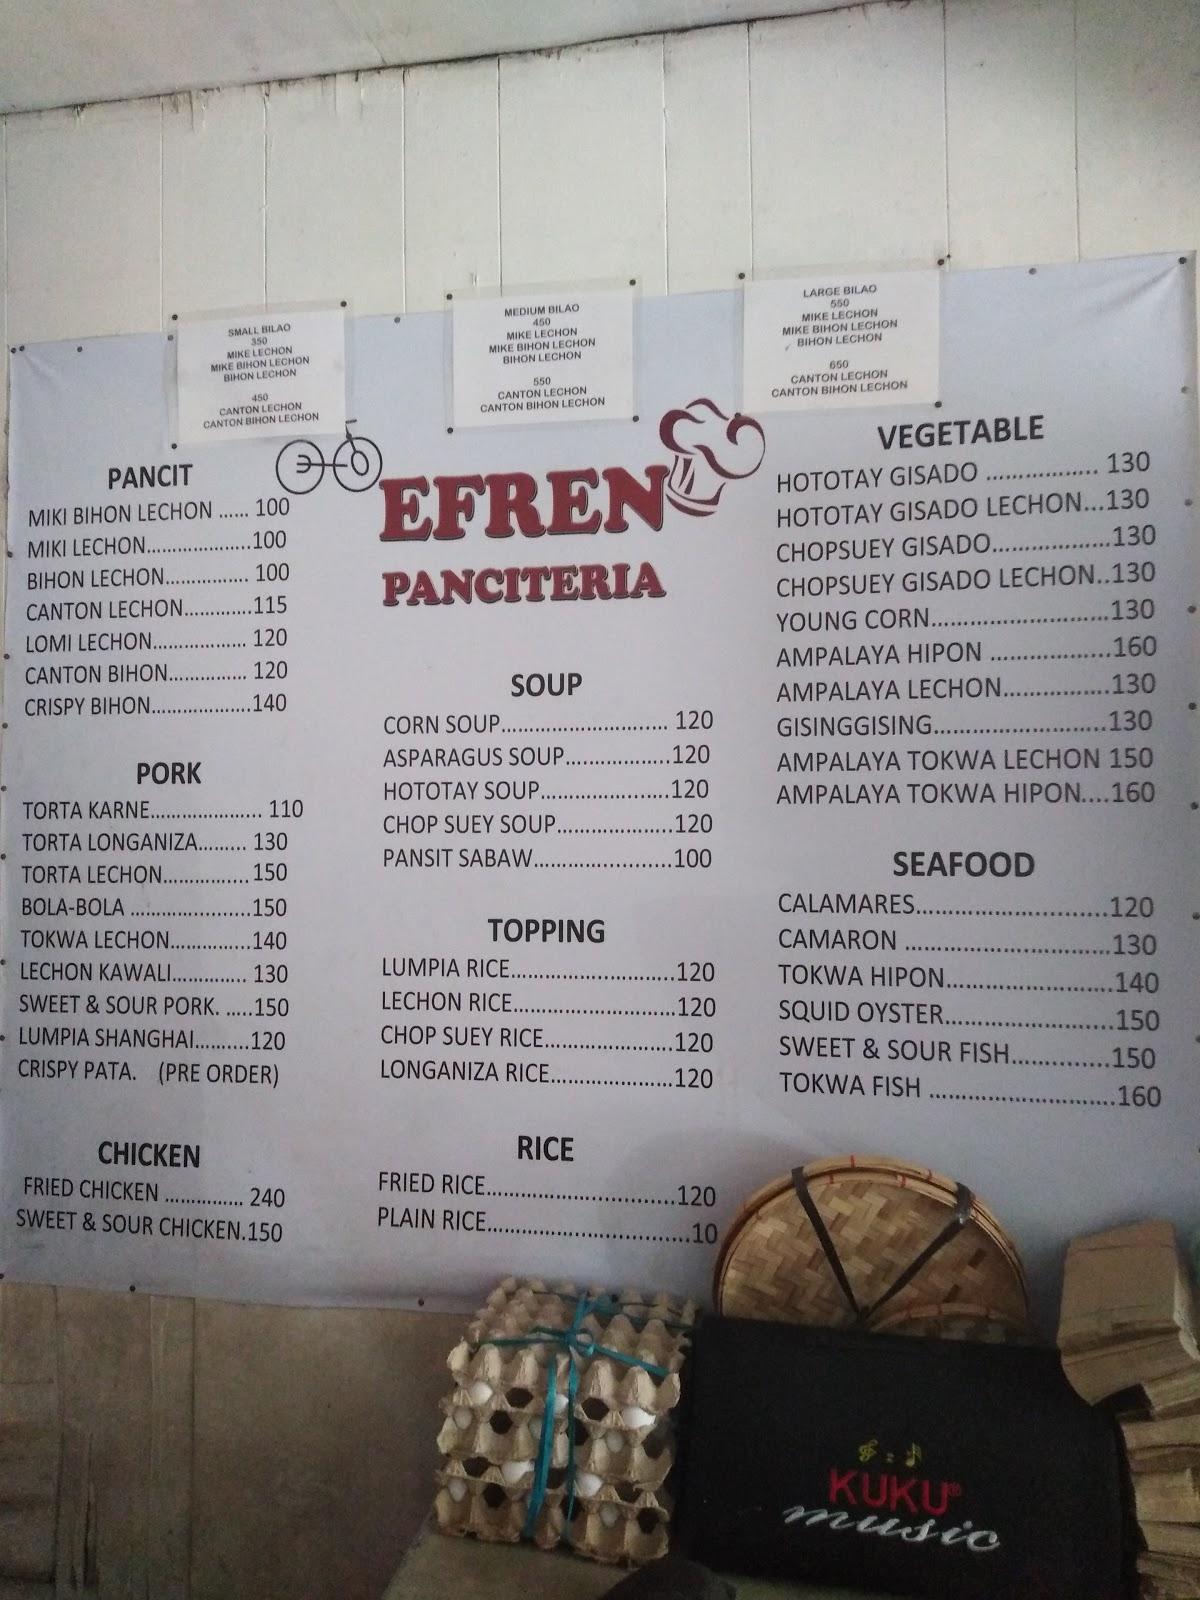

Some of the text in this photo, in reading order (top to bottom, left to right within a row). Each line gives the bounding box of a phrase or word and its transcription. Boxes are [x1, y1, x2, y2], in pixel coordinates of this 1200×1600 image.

[804, 285, 877, 298] LARGE BILAO
[505, 304, 579, 317] MEDIUM BILAO
[831, 298, 849, 308] 550
[533, 318, 550, 326] 450
[802, 308, 878, 321] MIKE LECHON
[228, 323, 291, 337] SMALL BILAO
[507, 328, 577, 340] MIKE LECHON
[783, 319, 897, 335] MIKE BIHON LECHON
[252, 337, 267, 345] 350
[489, 338, 595, 353] MIKE BIHON LECHON
[797, 333, 882, 347] BIHON LECHON
[227, 346, 292, 359] MIKE LECHON
[503, 351, 581, 364] BIHON LECHON
[211, 356, 309, 372] MIKE BIHON LECHON
[830, 360, 848, 369] 650
[224, 369, 296, 382] BIHON LECHON
[534, 377, 551, 386] 550
[791, 370, 887, 384] CANTON LECHON
[252, 393, 268, 402] 450
[498, 386, 586, 400] CANTON LECHON
[772, 381, 907, 398] CANTON BIHON LECHON
[220, 402, 301, 416] CANTON LECHON
[481, 397, 605, 412] CANTON BIHON LECHON
[204, 412, 318, 429] CANTON BIHON LECHON
[878, 415, 1044, 450] VEGETABLE
[109, 464, 193, 490] PANCIT
[778, 451, 1150, 493] HOTOTAY GISADO 130
[29, 498, 289, 527] MIKI BIHON LECHON 100
[379, 465, 669, 541] EFREN
[778, 498, 977, 528] HOTOTAY GISADO
[28, 540, 65, 558] MIKI
[777, 538, 894, 563] CHOPSUEY
[28, 563, 289, 590] BIHON 100
[382, 562, 666, 606] PANCITERIA
[777, 569, 990, 597] CHOPSUEY GISADO
[27, 602, 101, 621] CANTON
[777, 611, 856, 632] YOUNG
[27, 628, 287, 653] LOMI 120
[777, 642, 981, 667] AMPALAYA HIPON
[26, 661, 287, 684] CANTON 120
[512, 673, 582, 697] SOUP
[777, 680, 900, 702] AMPALAYA
[25, 698, 85, 716] CRISPY
[384, 710, 713, 734] CORN 120
[384, 748, 502, 767] ASPARAGUS
[777, 747, 1153, 772] AMPALAYA TOKWA LECHON 150
[137, 762, 201, 784] PORK
[385, 782, 478, 800] HOTOTAY
[777, 784, 900, 804] AMPALAYA
[907, 783, 995, 803] TOKWA
[23, 802, 82, 819] TORTA
[270, 800, 303, 818] 110
[384, 815, 494, 833] CHOP SUEY
[22, 833, 81, 851] TORTA
[255, 832, 287, 850] 130
[384, 849, 453, 867] PANSIT
[894, 852, 1035, 877] SEAFOOD
[22, 863, 287, 883] TORTA 150
[23, 898, 124, 916] BOLA-BOLA
[21, 930, 88, 948] TOKWA
[488, 919, 604, 943] TOPPING
[779, 929, 896, 950] CAMARON
[21, 962, 92, 980] LECHON
[255, 965, 287, 983] 130
[383, 958, 460, 977] LUMPIA
[778, 965, 863, 986] TOKWA
[20, 994, 80, 1013] SWEET
[86, 995, 99, 1013] &
[106, 996, 157, 1015] SOUR
[383, 992, 461, 1011] LECHON
[780, 1000, 849, 1022] SQUID
[20, 1027, 89, 1046] LUMPIA
[381, 1025, 493, 1046] CHOP SUEY
[780, 1036, 951, 1062] SWEET & SOUR
[19, 1059, 78, 1079] CRISPY
[159, 1062, 200, 1085] (PRE
[207, 1064, 278, 1088] ORDER)
[382, 1060, 498, 1081] LONGANIZA
[779, 1072, 920, 1097] TOKWA FISH
[98, 1141, 200, 1168] CHICKEN
[518, 1136, 573, 1161] RICE
[25, 1177, 285, 1207] FRIED CHICKEN 240
[379, 1172, 434, 1192] FRIED
[17, 1209, 152, 1235] SWEET & SOUR
[378, 1207, 434, 1229] PLAIN
[783, 1505, 1000, 1550] music
